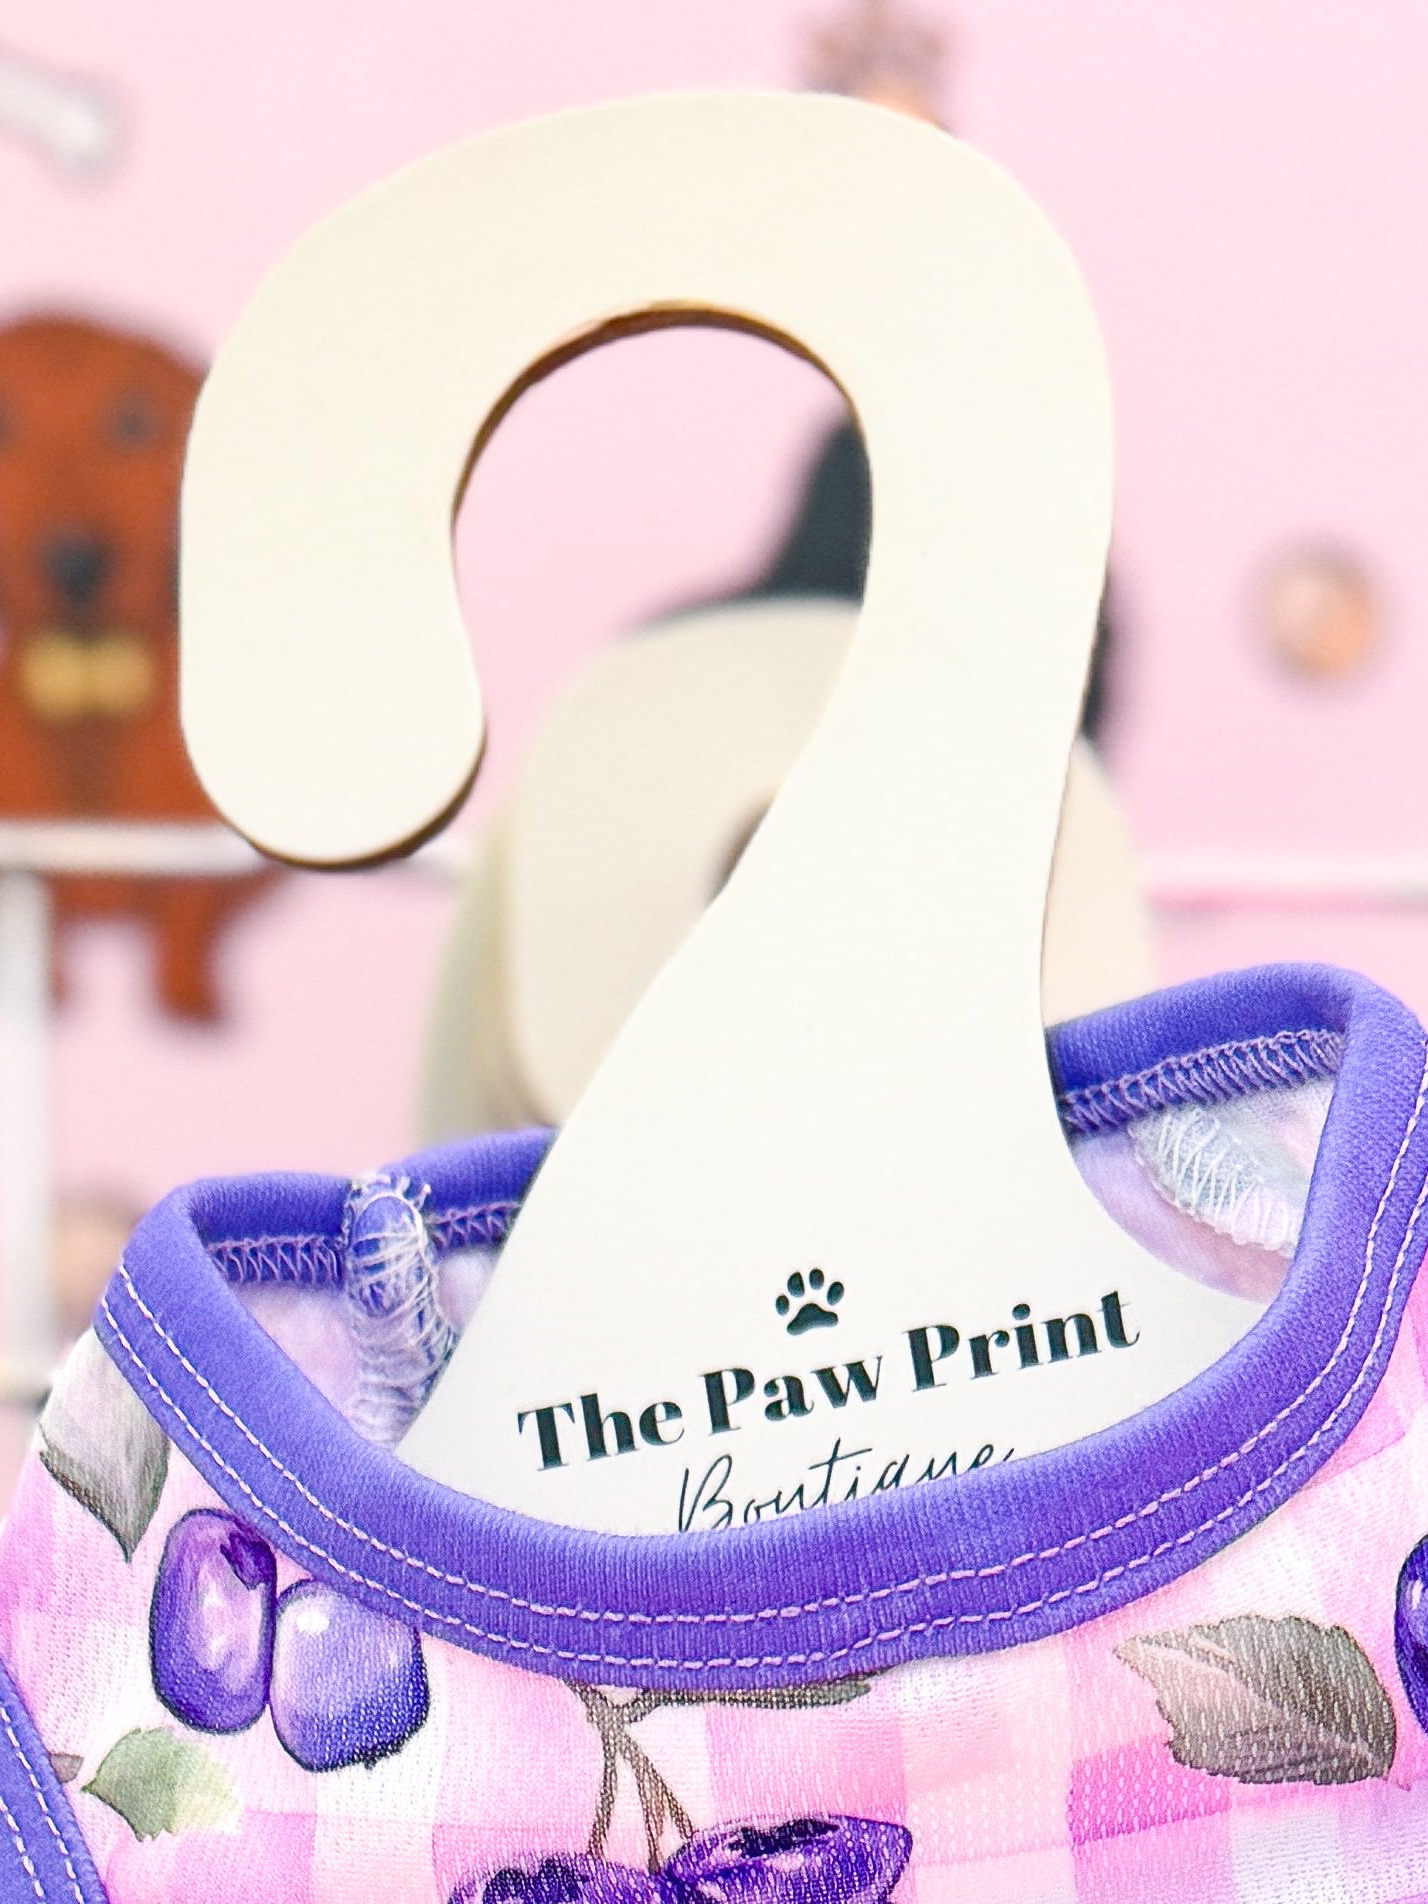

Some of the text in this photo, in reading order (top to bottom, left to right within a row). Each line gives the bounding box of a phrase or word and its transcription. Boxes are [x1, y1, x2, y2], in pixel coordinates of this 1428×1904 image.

[517, 1290, 1140, 1471] The Paw Print
